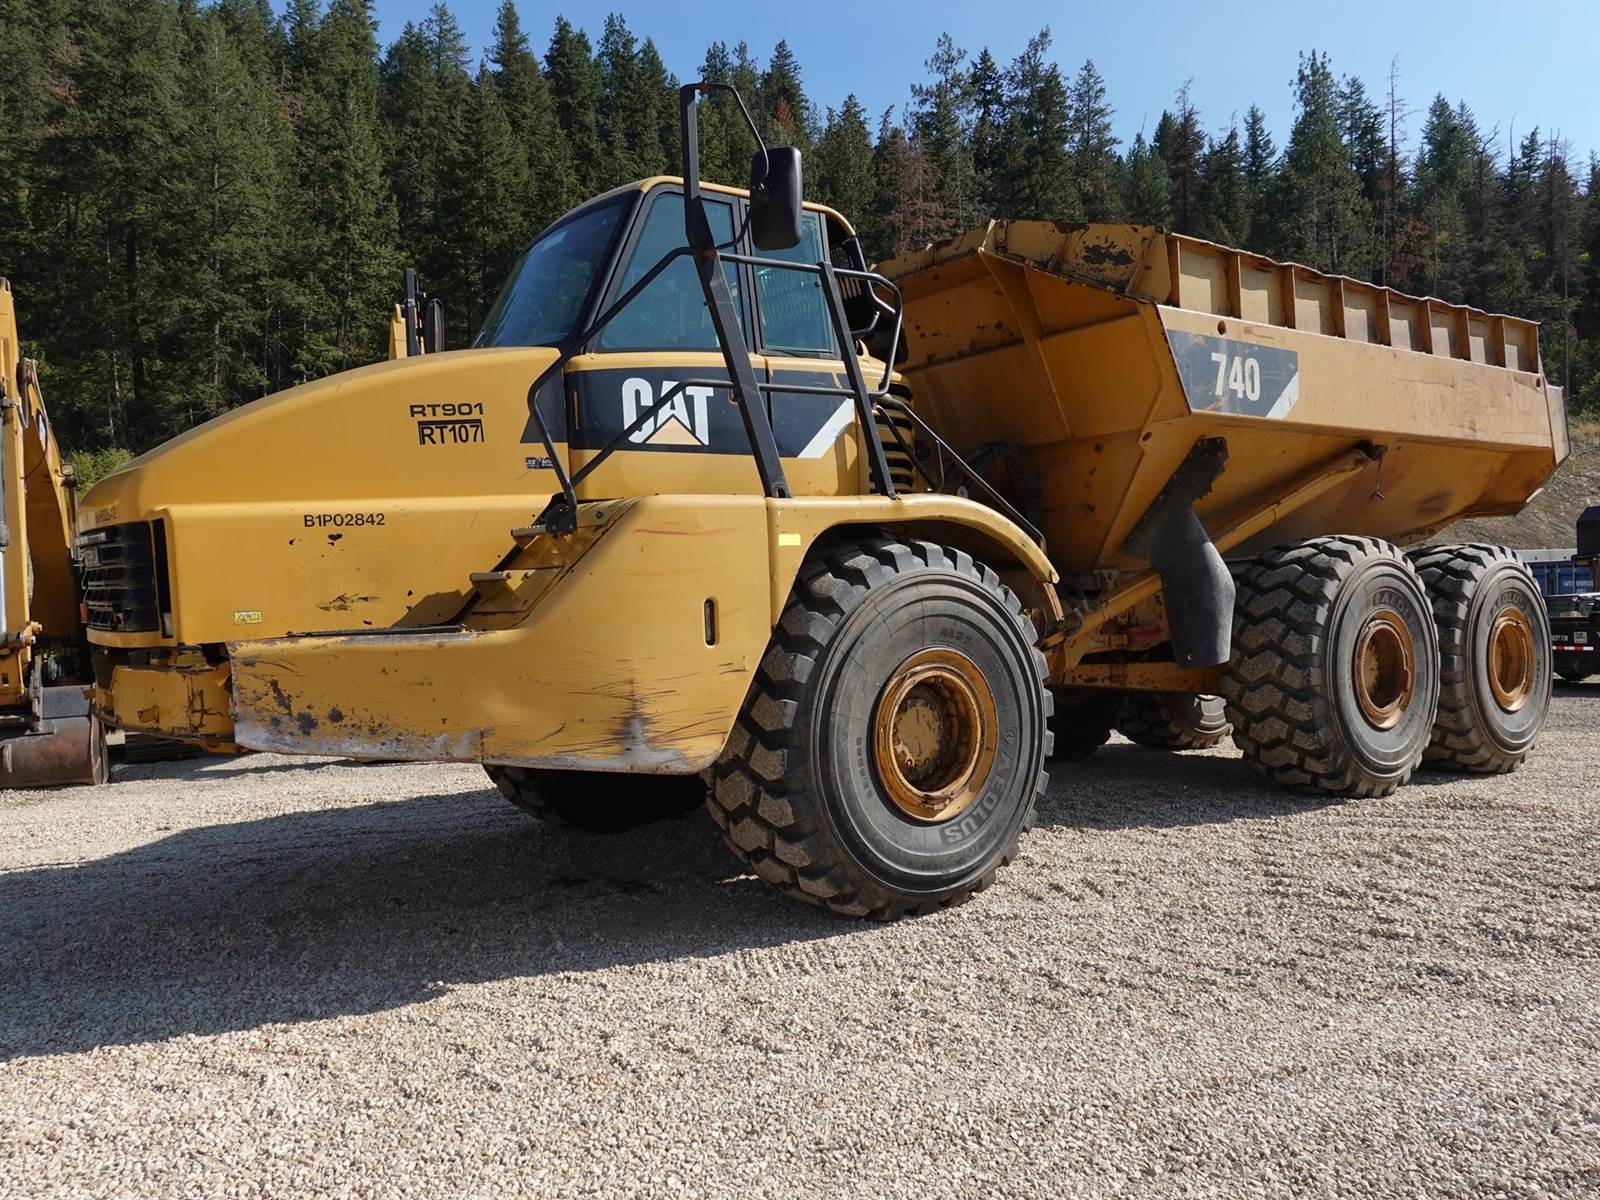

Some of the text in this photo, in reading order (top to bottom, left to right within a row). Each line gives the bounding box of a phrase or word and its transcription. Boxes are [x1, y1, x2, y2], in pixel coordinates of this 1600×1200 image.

[1210, 351, 1261, 402] 740
[409, 402, 484, 417] RT901
[621, 377, 714, 446] CAT
[420, 423, 480, 445] RT107
[303, 513, 386, 527] B1P02842
